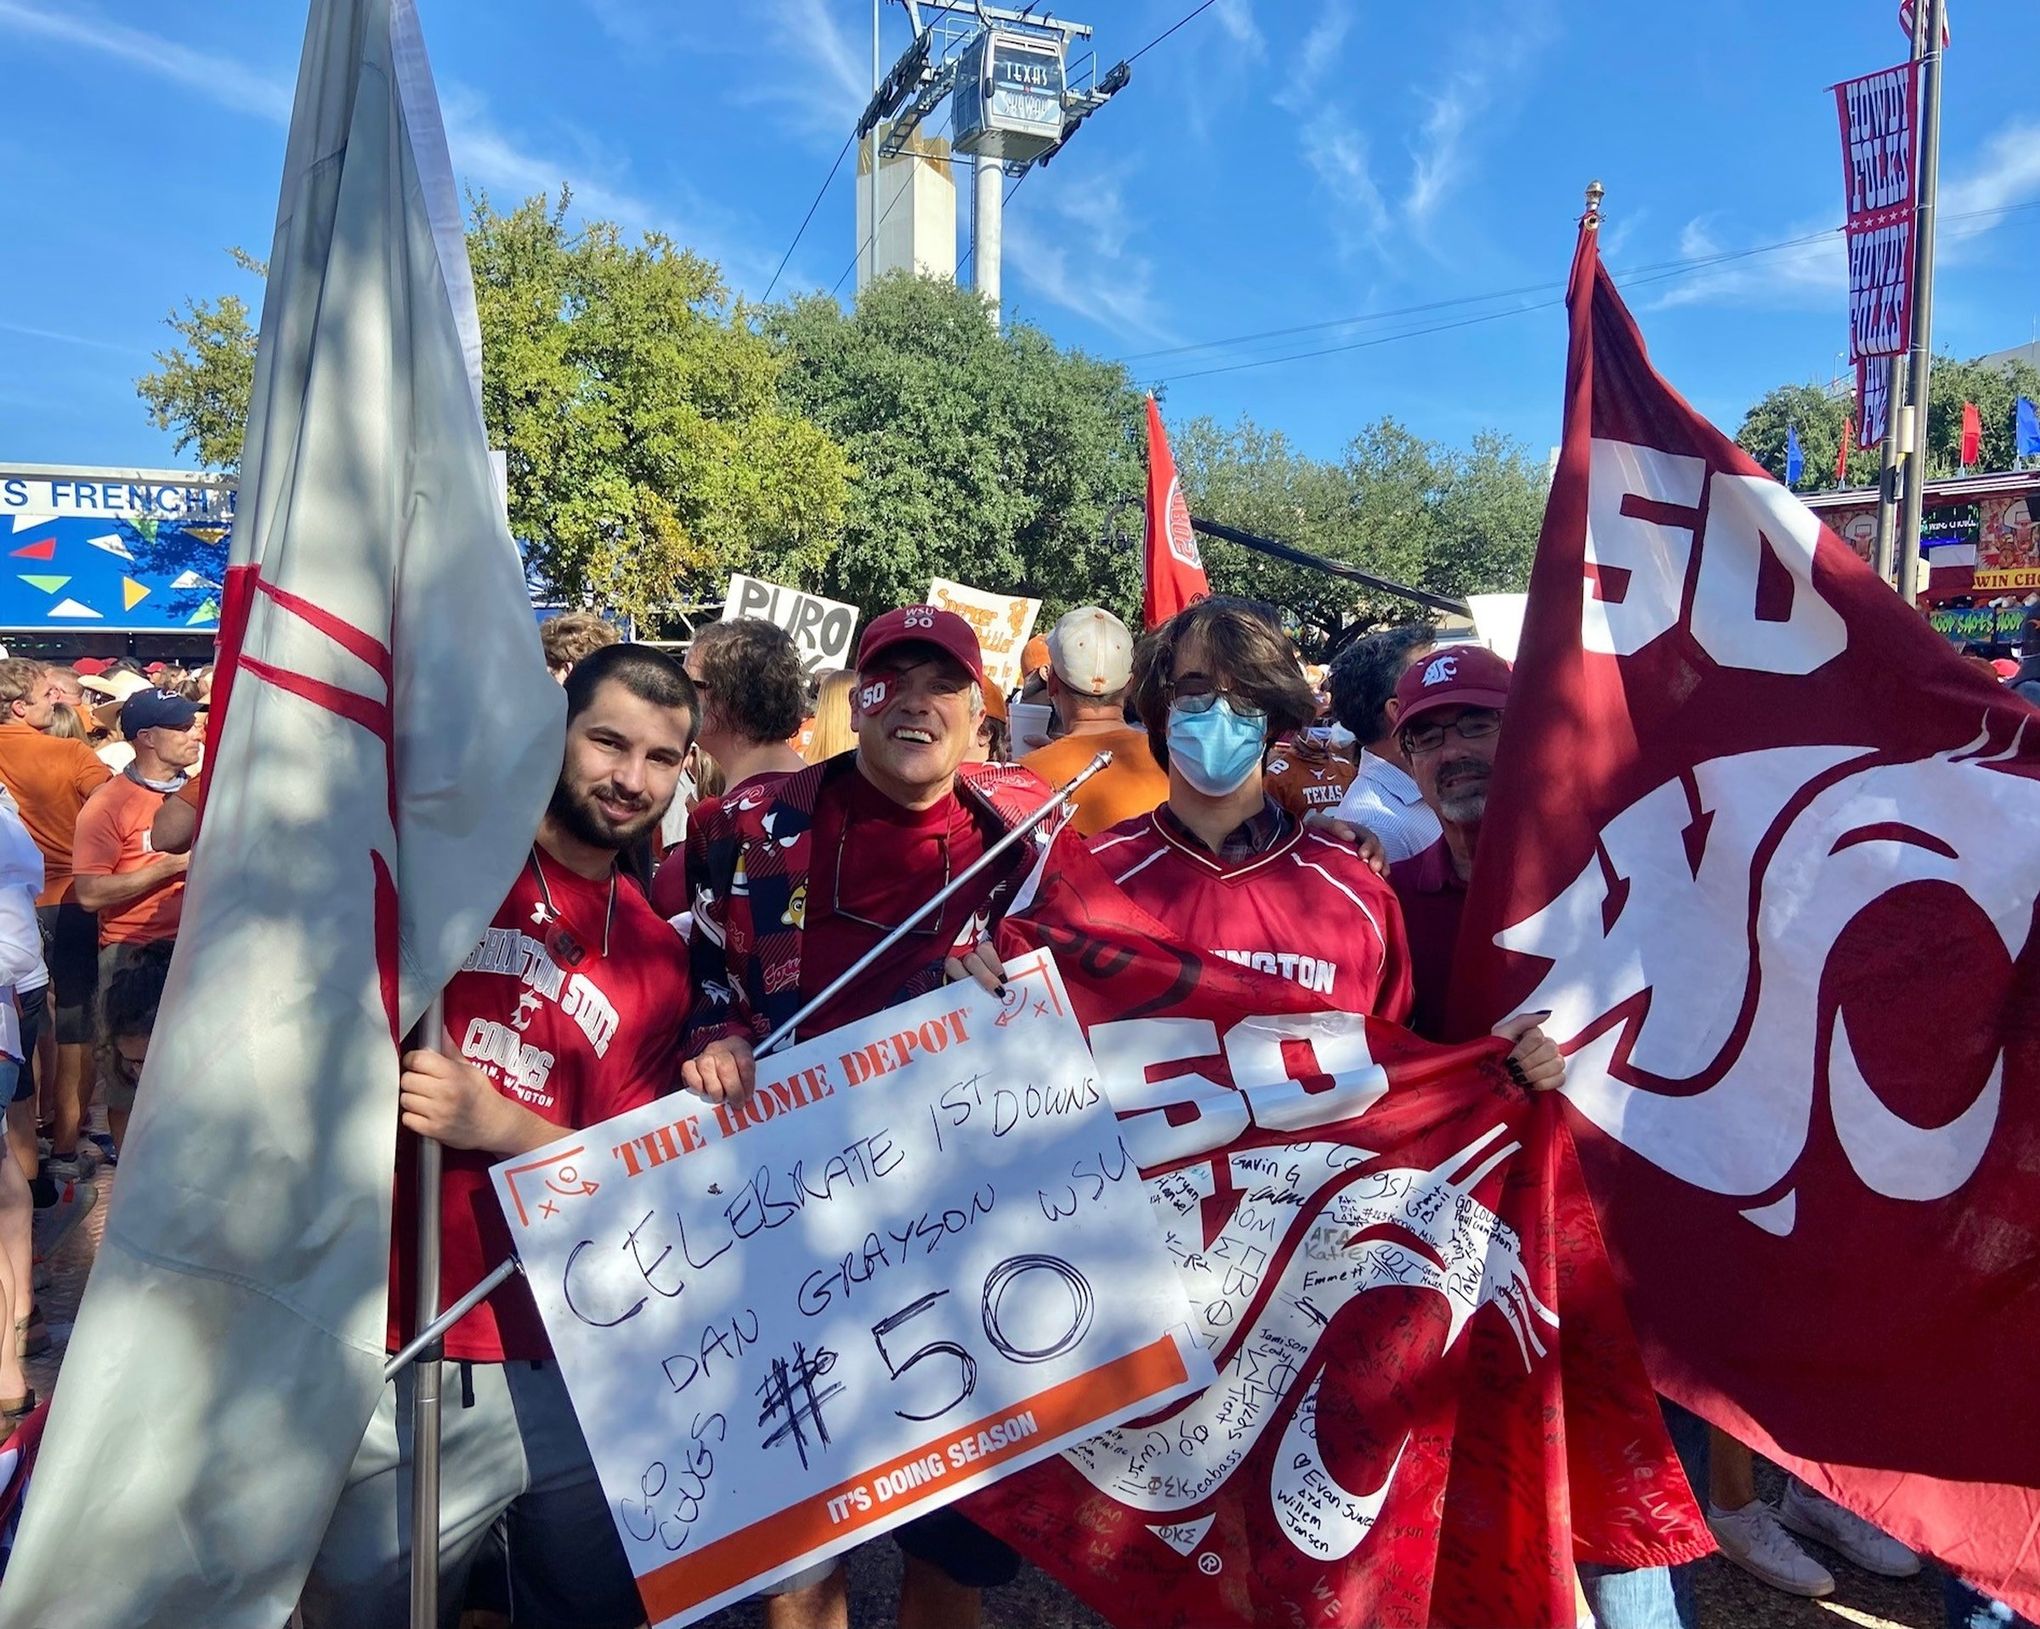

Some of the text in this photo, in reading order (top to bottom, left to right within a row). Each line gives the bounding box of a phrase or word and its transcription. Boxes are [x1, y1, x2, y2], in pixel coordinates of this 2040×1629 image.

[1006, 61, 1048, 87] TEXAS
[1846, 67, 1909, 143] HOWDY
[1851, 130, 1909, 213] FOLKS
[1850, 222, 1909, 291] HOWDY
[1850, 282, 1906, 359] FOLKS
[3, 478, 29, 507] S
[50, 480, 209, 513] FRENCH
[1581, 437, 1848, 674] 50
[1975, 574, 2009, 587] WIN
[739, 579, 853, 657] PURO
[862, 681, 887, 709] 50
[1302, 784, 1344, 805] TEXAS
[1207, 949, 1337, 995] NGTON
[560, 972, 620, 1060] STATE
[461, 1017, 555, 1093] COUGRS
[612, 1007, 974, 1178] THE HOME DEPOT
[1088, 1010, 1390, 1169] 50
[564, 1070, 1100, 1326] CELEBRATE 1ST DOWNS
[1231, 1154, 1279, 1177] Gavin
[662, 1135, 1134, 1394] DAN GRAYSON WSU
[826, 1486, 873, 1524] IT'S
[875, 1450, 944, 1498] DOING
[946, 1410, 1039, 1469] SEASON
[1302, 1467, 1341, 1509] Evan
[1277, 1489, 1322, 1530] Willem
